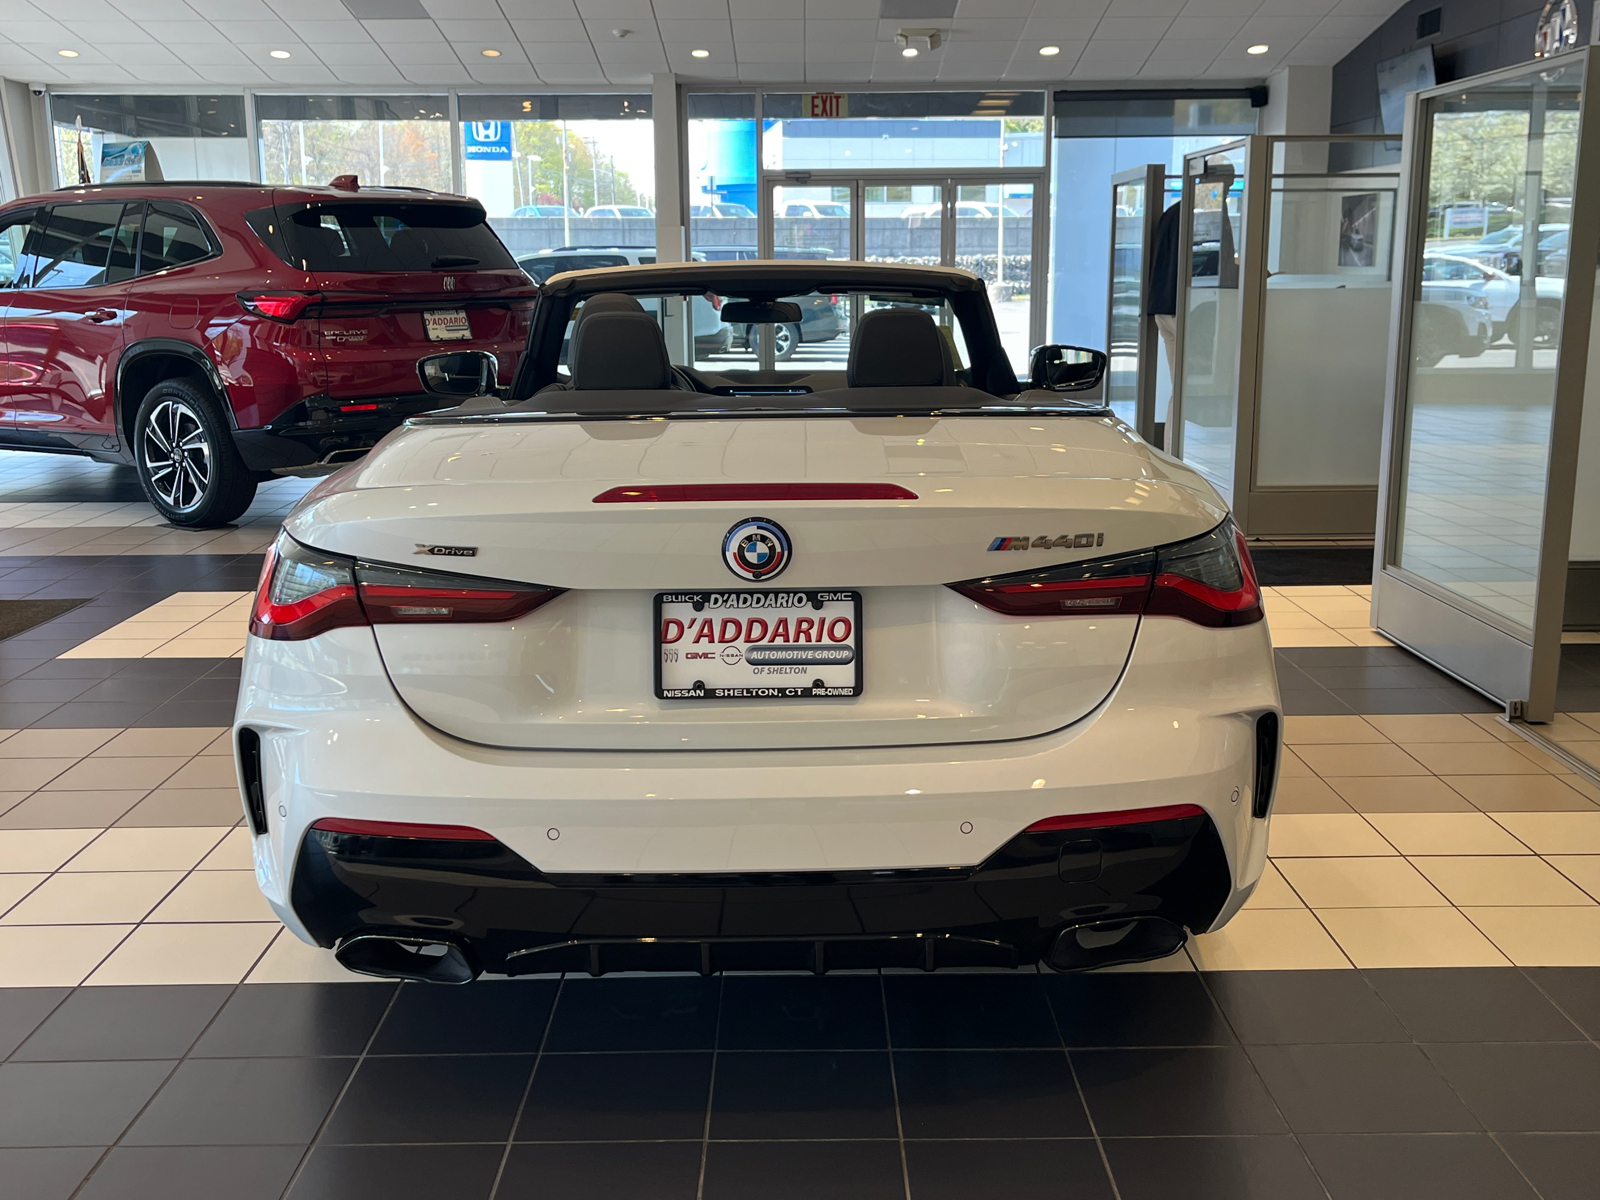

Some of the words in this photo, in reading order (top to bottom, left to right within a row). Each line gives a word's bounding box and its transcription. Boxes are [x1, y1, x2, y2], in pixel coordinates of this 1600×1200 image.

[811, 95, 841, 117] EXIT
[425, 316, 467, 326] D'ADDARIO
[740, 534, 774, 548] BMW
[663, 594, 703, 602] BUICK
[709, 593, 808, 609] D'ADDARIO
[817, 592, 852, 601] GMC
[661, 616, 852, 644] D'ADDARIO
[685, 652, 716, 660] GMC
[750, 650, 813, 660] AUTOMOTIVE
[815, 650, 849, 659] GROUP
[752, 667, 766, 675] OF
[766, 667, 808, 675] SHELTON
[663, 689, 705, 698] NISSAN
[715, 688, 782, 697] SHELTON,
[785, 688, 804, 696] CT
[812, 688, 854, 696] PRE-OWNED
